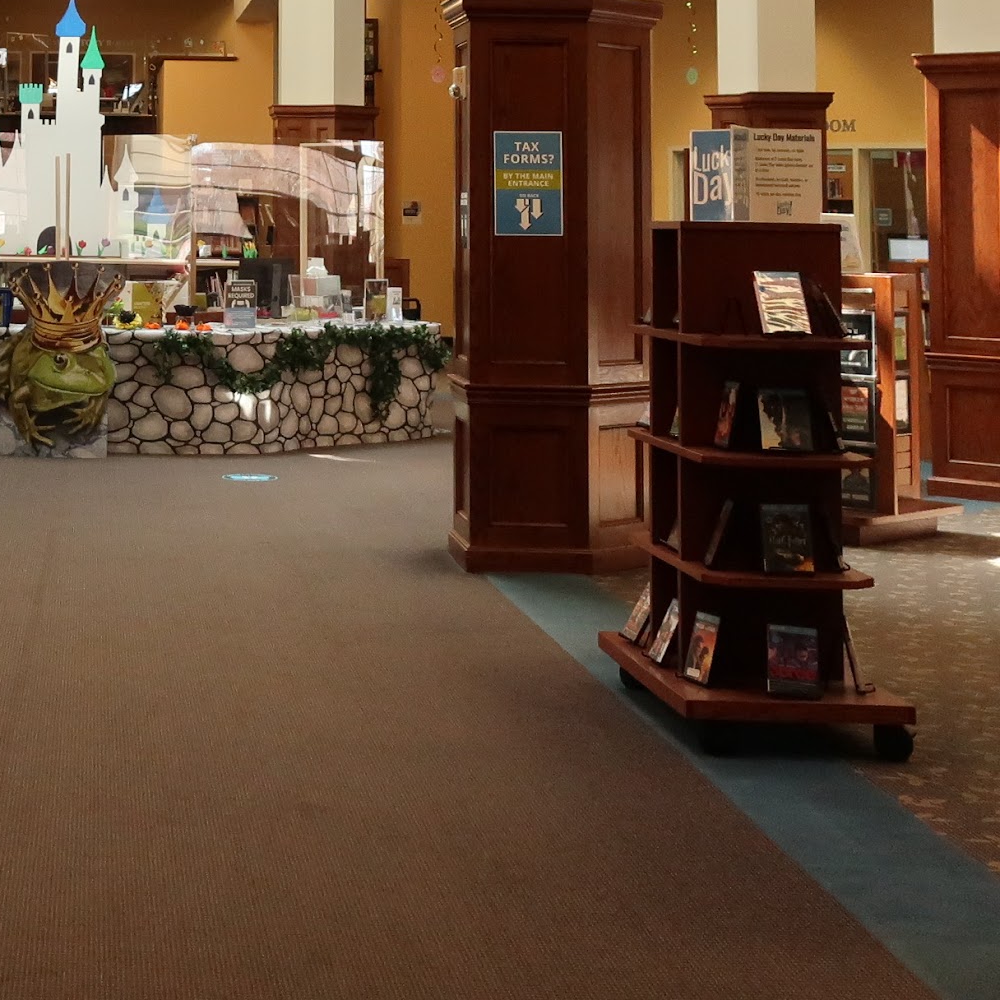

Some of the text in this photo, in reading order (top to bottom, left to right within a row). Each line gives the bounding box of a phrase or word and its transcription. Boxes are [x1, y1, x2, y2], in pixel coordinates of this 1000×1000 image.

[753, 133, 816, 142] Lucky Day Materials
[514, 142, 540, 152] TAX
[503, 154, 555, 165] FORMS?
[507, 180, 550, 188] ENTRANCE
